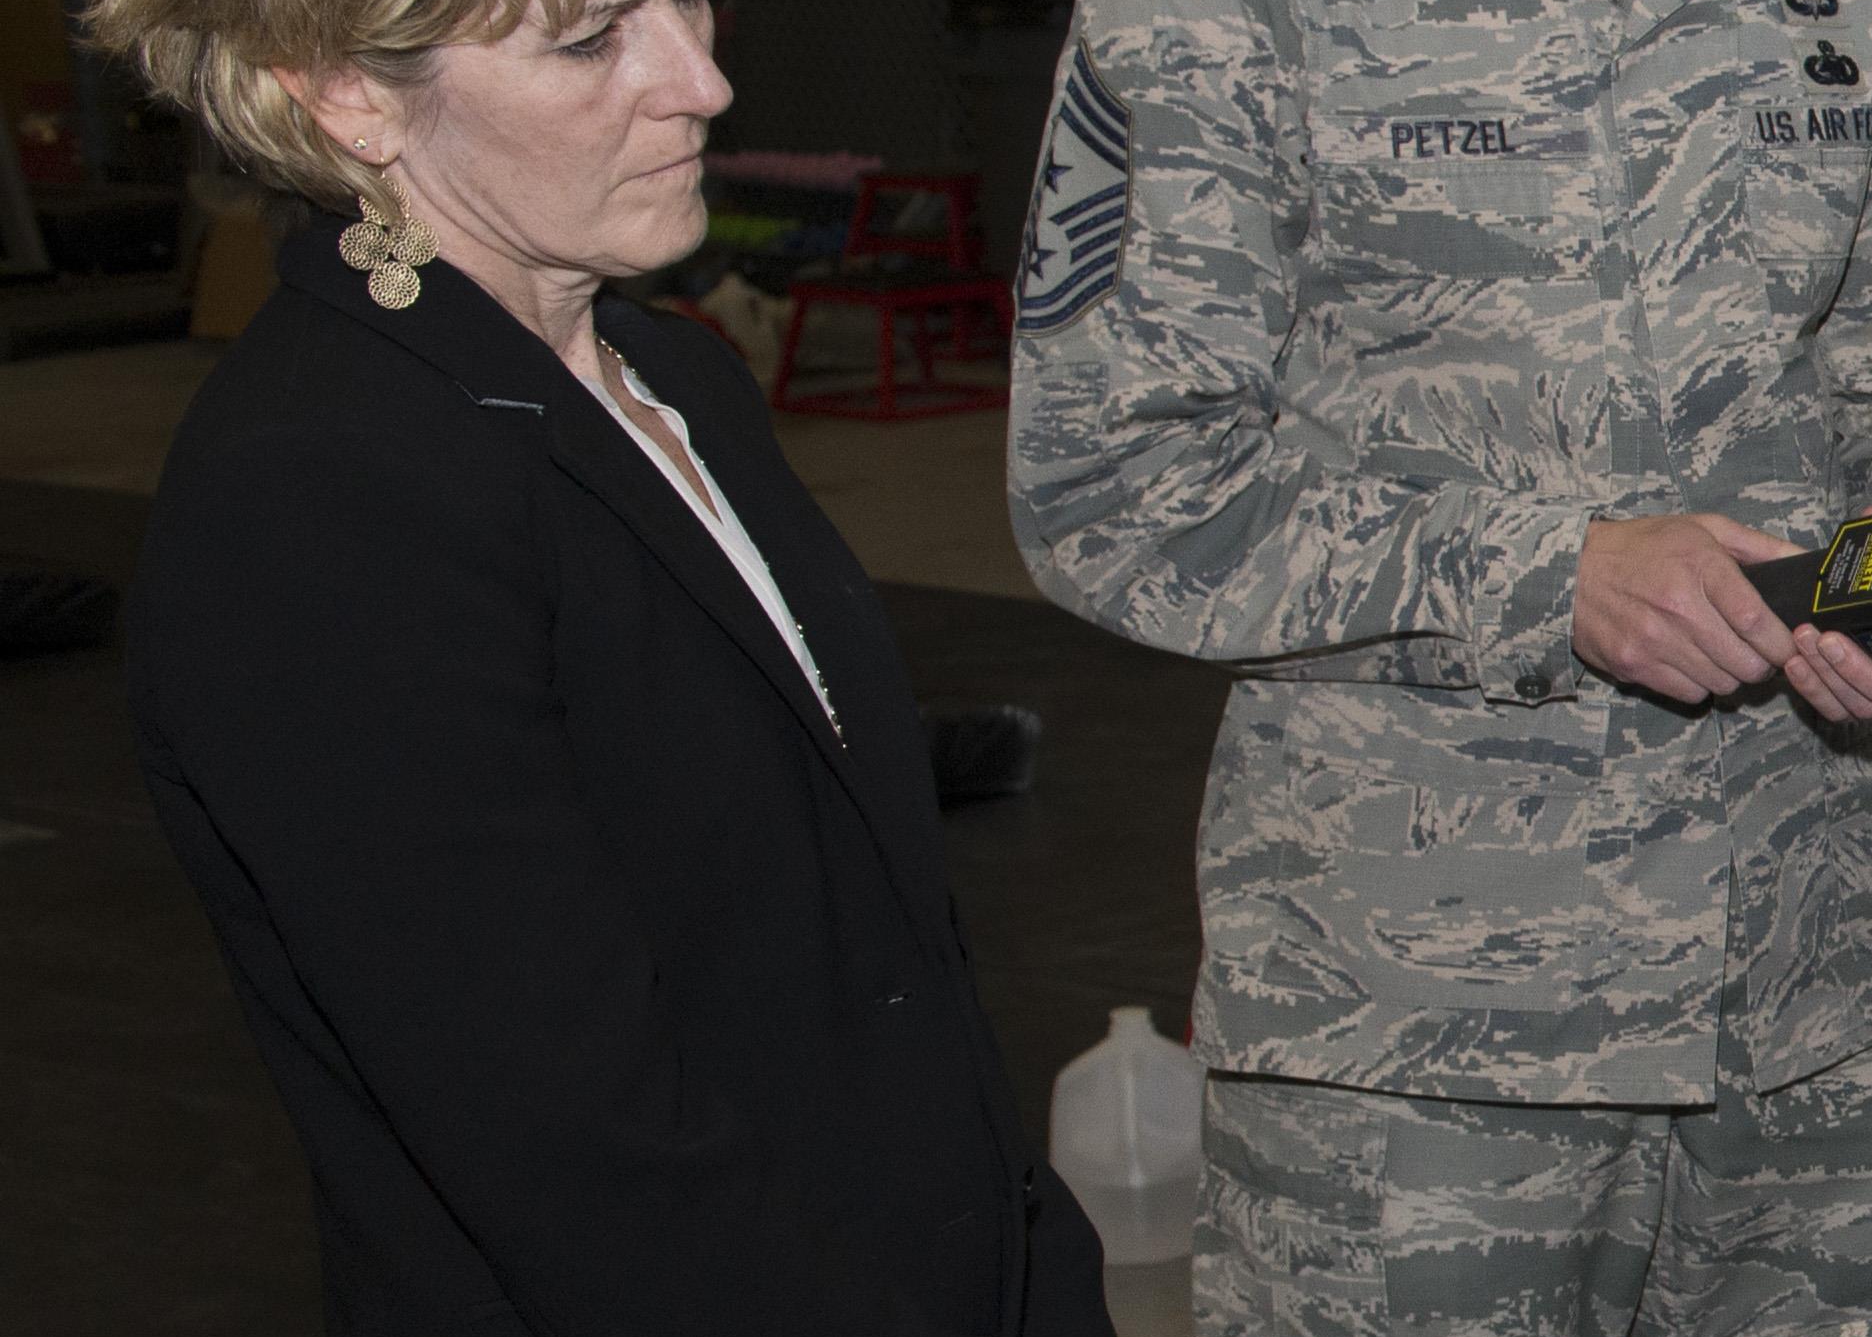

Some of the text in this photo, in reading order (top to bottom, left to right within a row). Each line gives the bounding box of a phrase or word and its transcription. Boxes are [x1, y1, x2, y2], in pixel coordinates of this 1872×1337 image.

[1391, 119, 1516, 159] PETZEL
[1755, 109, 1799, 144] U.S.
[1807, 109, 1846, 143] AIR
